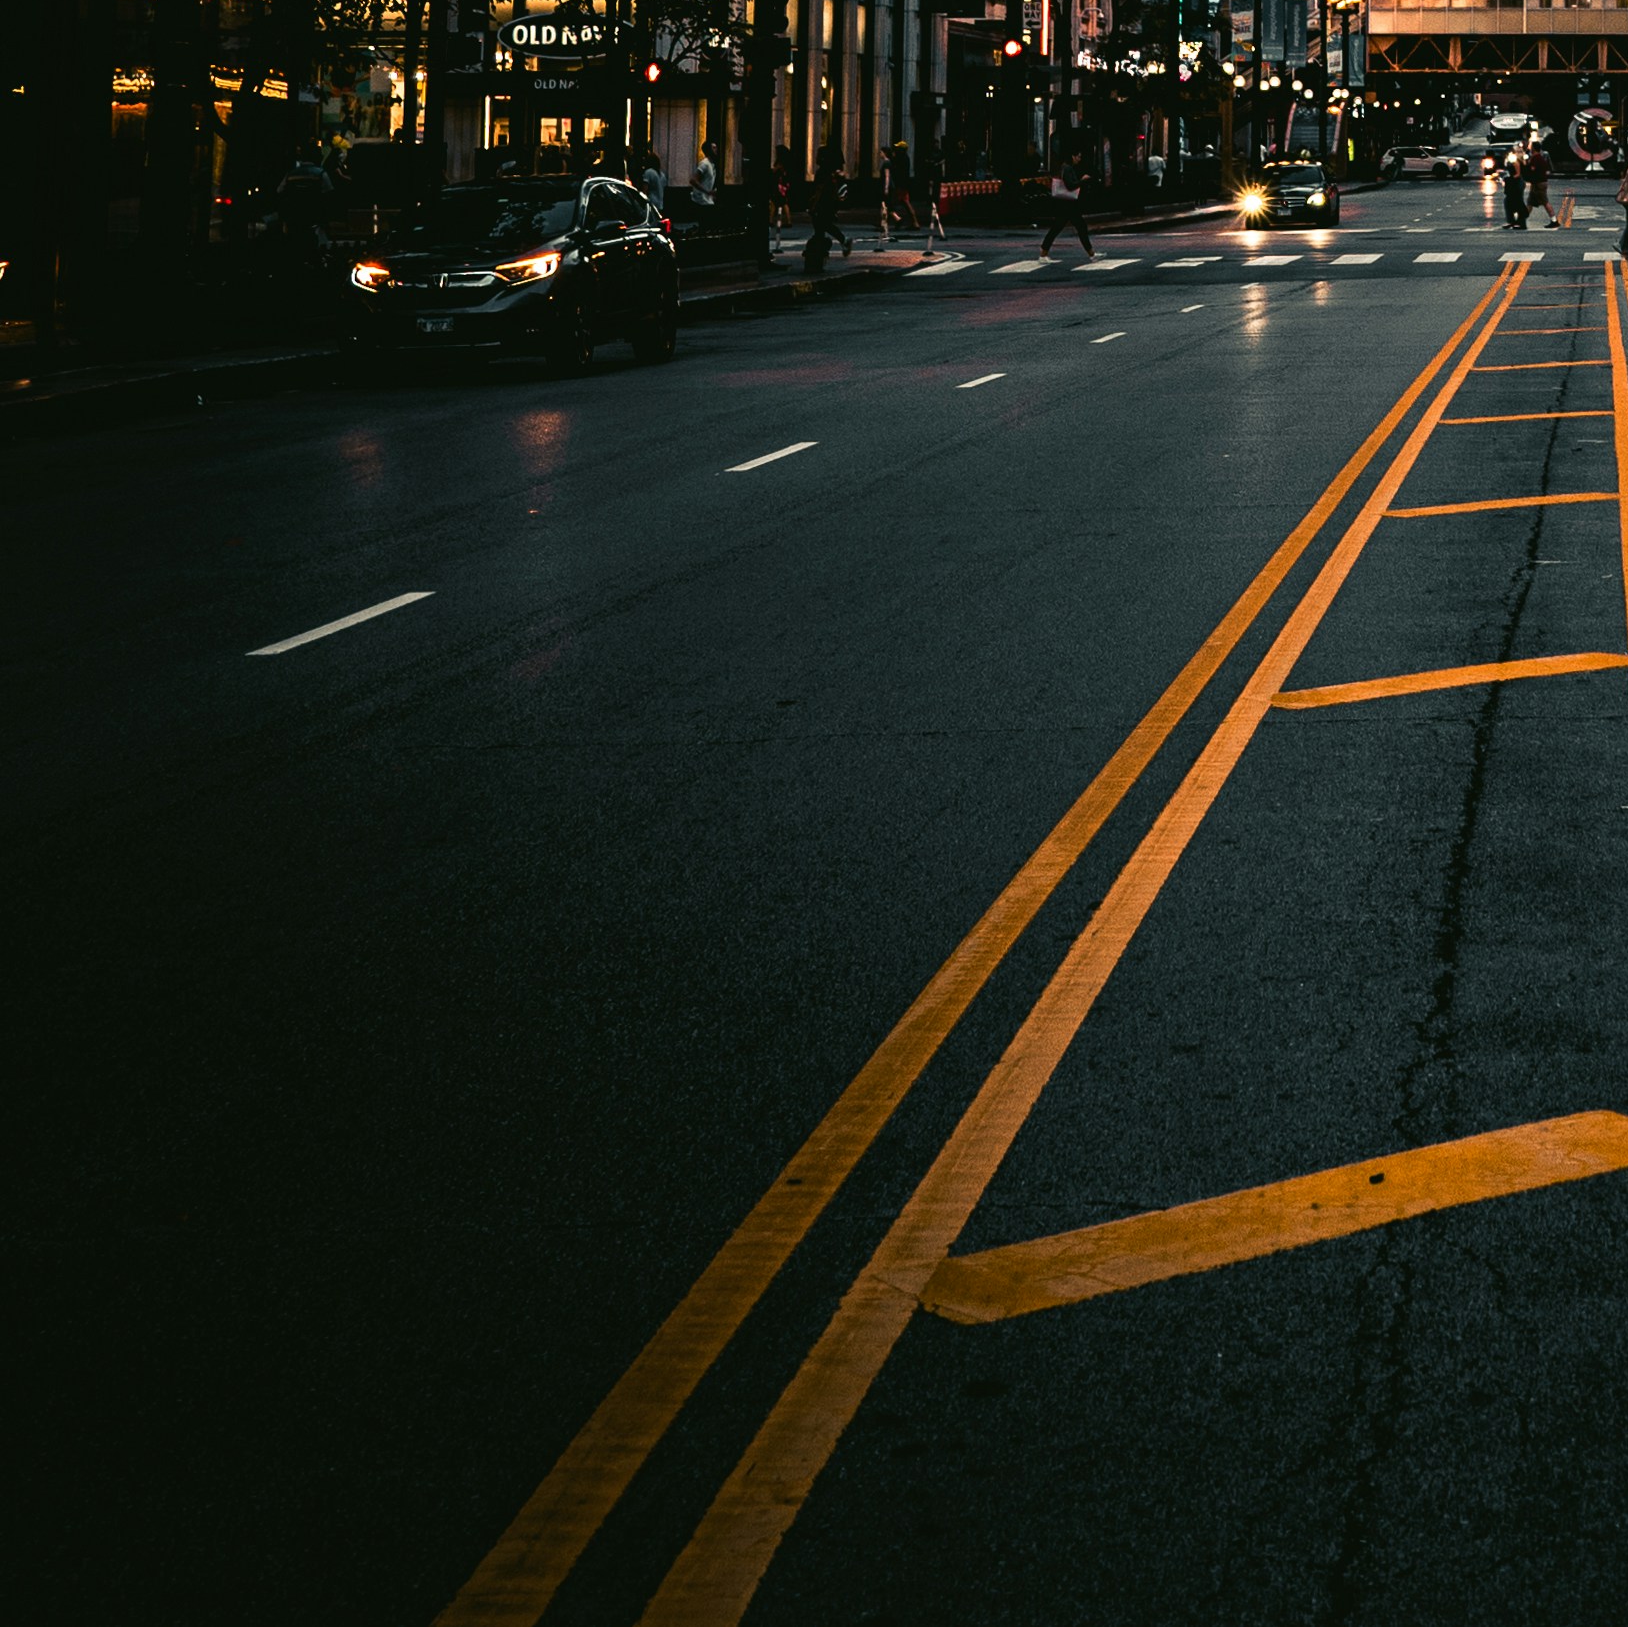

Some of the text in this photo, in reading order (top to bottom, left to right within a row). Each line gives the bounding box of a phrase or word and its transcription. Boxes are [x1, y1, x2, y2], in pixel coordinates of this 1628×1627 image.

[512, 25, 620, 45] OLD NAV
[535, 79, 557, 89] OLD
